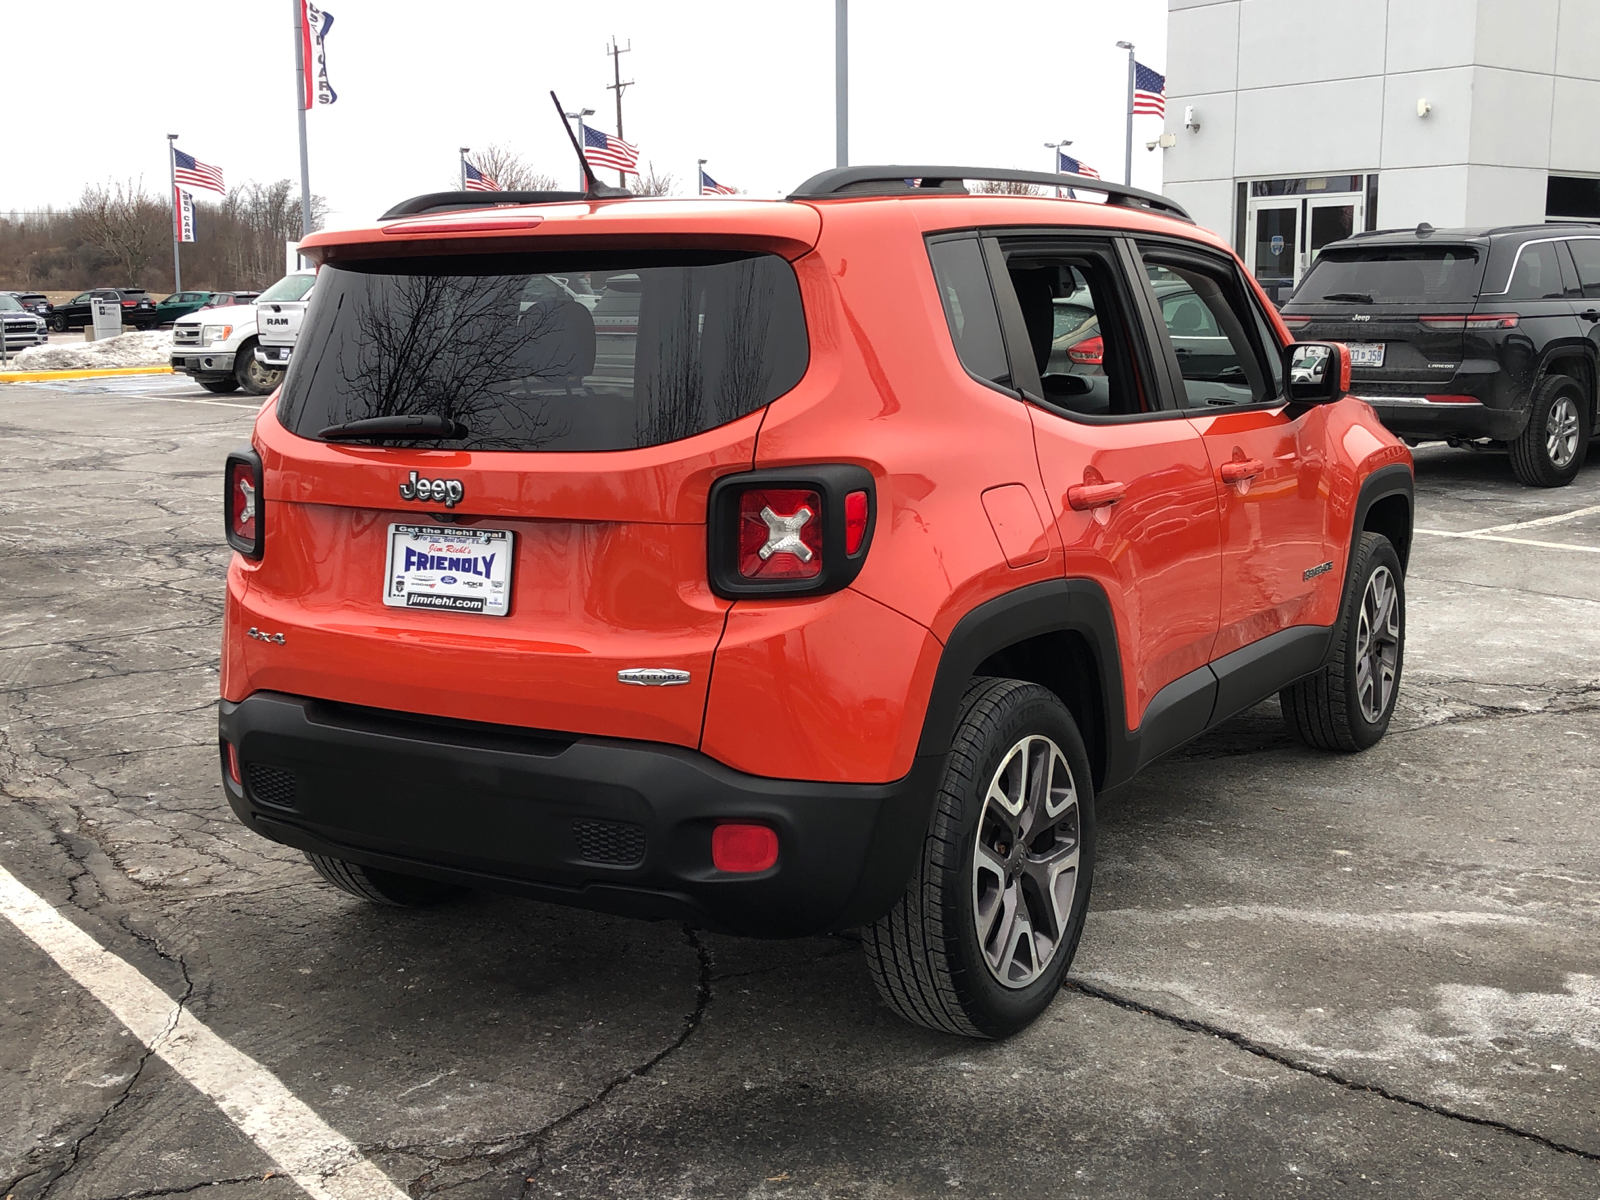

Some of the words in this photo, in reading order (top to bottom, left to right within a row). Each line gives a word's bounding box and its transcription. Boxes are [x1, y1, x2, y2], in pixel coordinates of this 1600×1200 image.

[309, 2, 322, 46] USD
[317, 54, 330, 104] CARS
[183, 215, 191, 240] CARS
[1352, 314, 1371, 322] Jeep
[399, 471, 464, 508] Jeep
[428, 544, 443, 554] Jim
[445, 545, 472, 554] Riehl's
[404, 546, 496, 579] FRIENDLY
[408, 595, 482, 609] jimriehl.com
